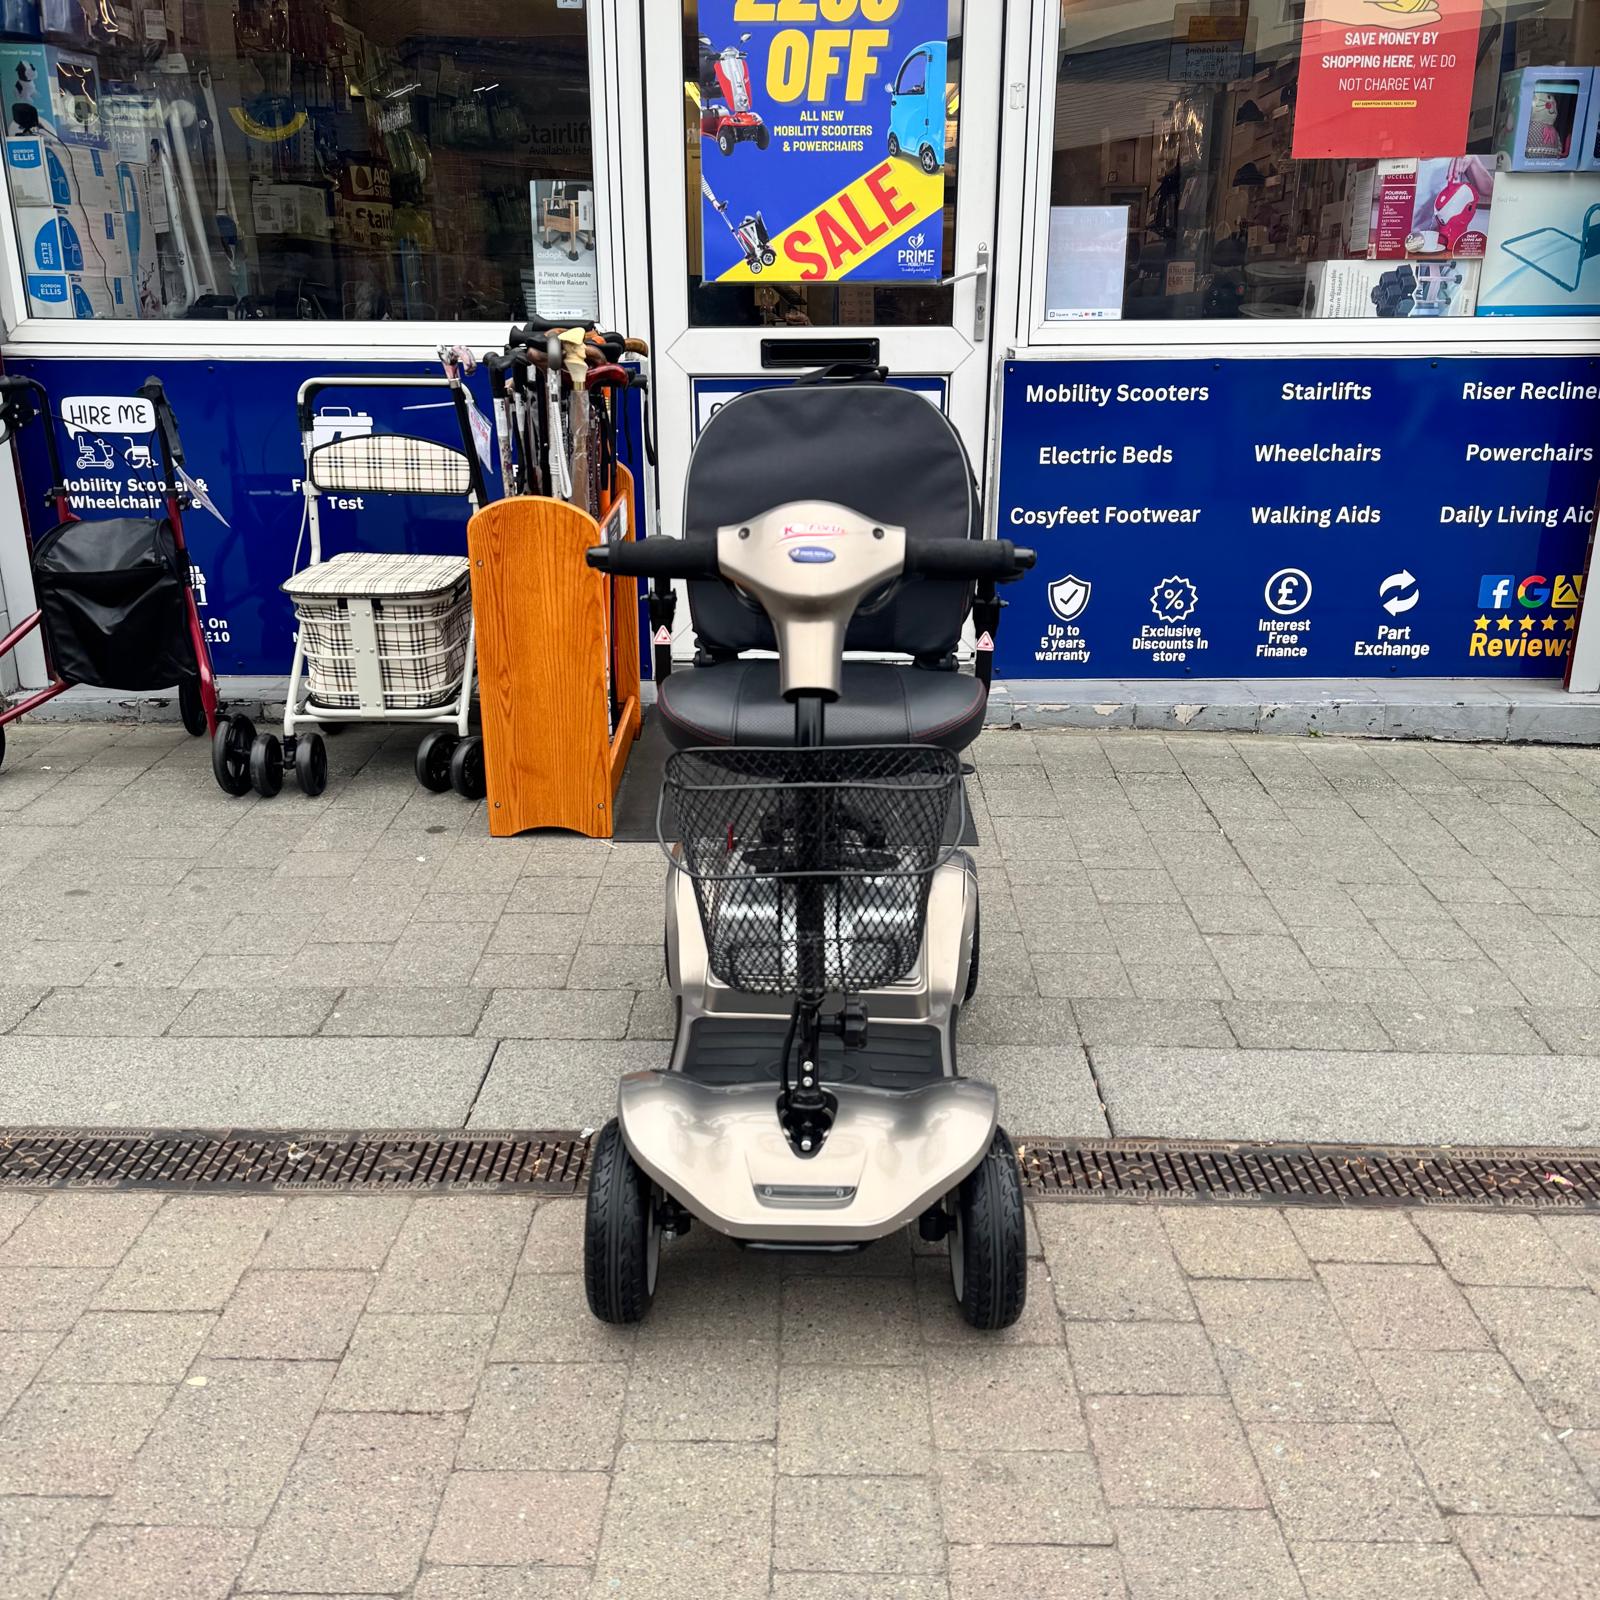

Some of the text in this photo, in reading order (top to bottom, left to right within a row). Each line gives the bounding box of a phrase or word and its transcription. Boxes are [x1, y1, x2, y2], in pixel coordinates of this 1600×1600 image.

[1344, 31, 1439, 45] SAVE MONEY BY
[766, 28, 889, 103] OFF
[1322, 54, 1456, 69] SHOPPING HERE, WE DO
[1338, 77, 1435, 91] NOT CHARGE VAT
[800, 110, 845, 121] ALL NEW
[774, 125, 873, 136] MOBILITY SCOOTERS
[783, 141, 864, 152] & POWERCHAIRS
[13, 153, 35, 161] ELLIS
[783, 163, 916, 280] SALE
[897, 249, 935, 263] PRIME
[560, 271, 592, 279] Adjustable
[1026, 383, 1209, 406] Mobility Scooters
[1281, 381, 1372, 401] Stairlifts
[1462, 381, 1516, 400] Riser
[71, 404, 147, 426] HIRE ME
[1039, 445, 1173, 465] Electric Beds
[1255, 443, 1382, 462] Wheelchairs
[1466, 443, 1594, 462] Powerchairs
[70, 495, 162, 509] Wheelchair
[327, 496, 365, 510] Test
[1010, 506, 1201, 528] Cosyfeet Footwear
[1251, 505, 1382, 528] Walking Aids
[1440, 505, 1493, 528] Daily
[1497, 505, 1559, 528] Living
[208, 617, 228, 629] On
[1258, 618, 1312, 632] Interest
[1047, 624, 1080, 639] Up to
[1141, 625, 1201, 638] Exclusive
[1268, 632, 1299, 644] Free
[1377, 625, 1411, 640] Part
[1040, 637, 1086, 652] 5 years
[1132, 637, 1209, 650] Discounts In
[1256, 644, 1308, 657] Finance
[1354, 641, 1430, 660] Exchange
[1034, 650, 1091, 663] warranty
[1152, 650, 1186, 662] store
